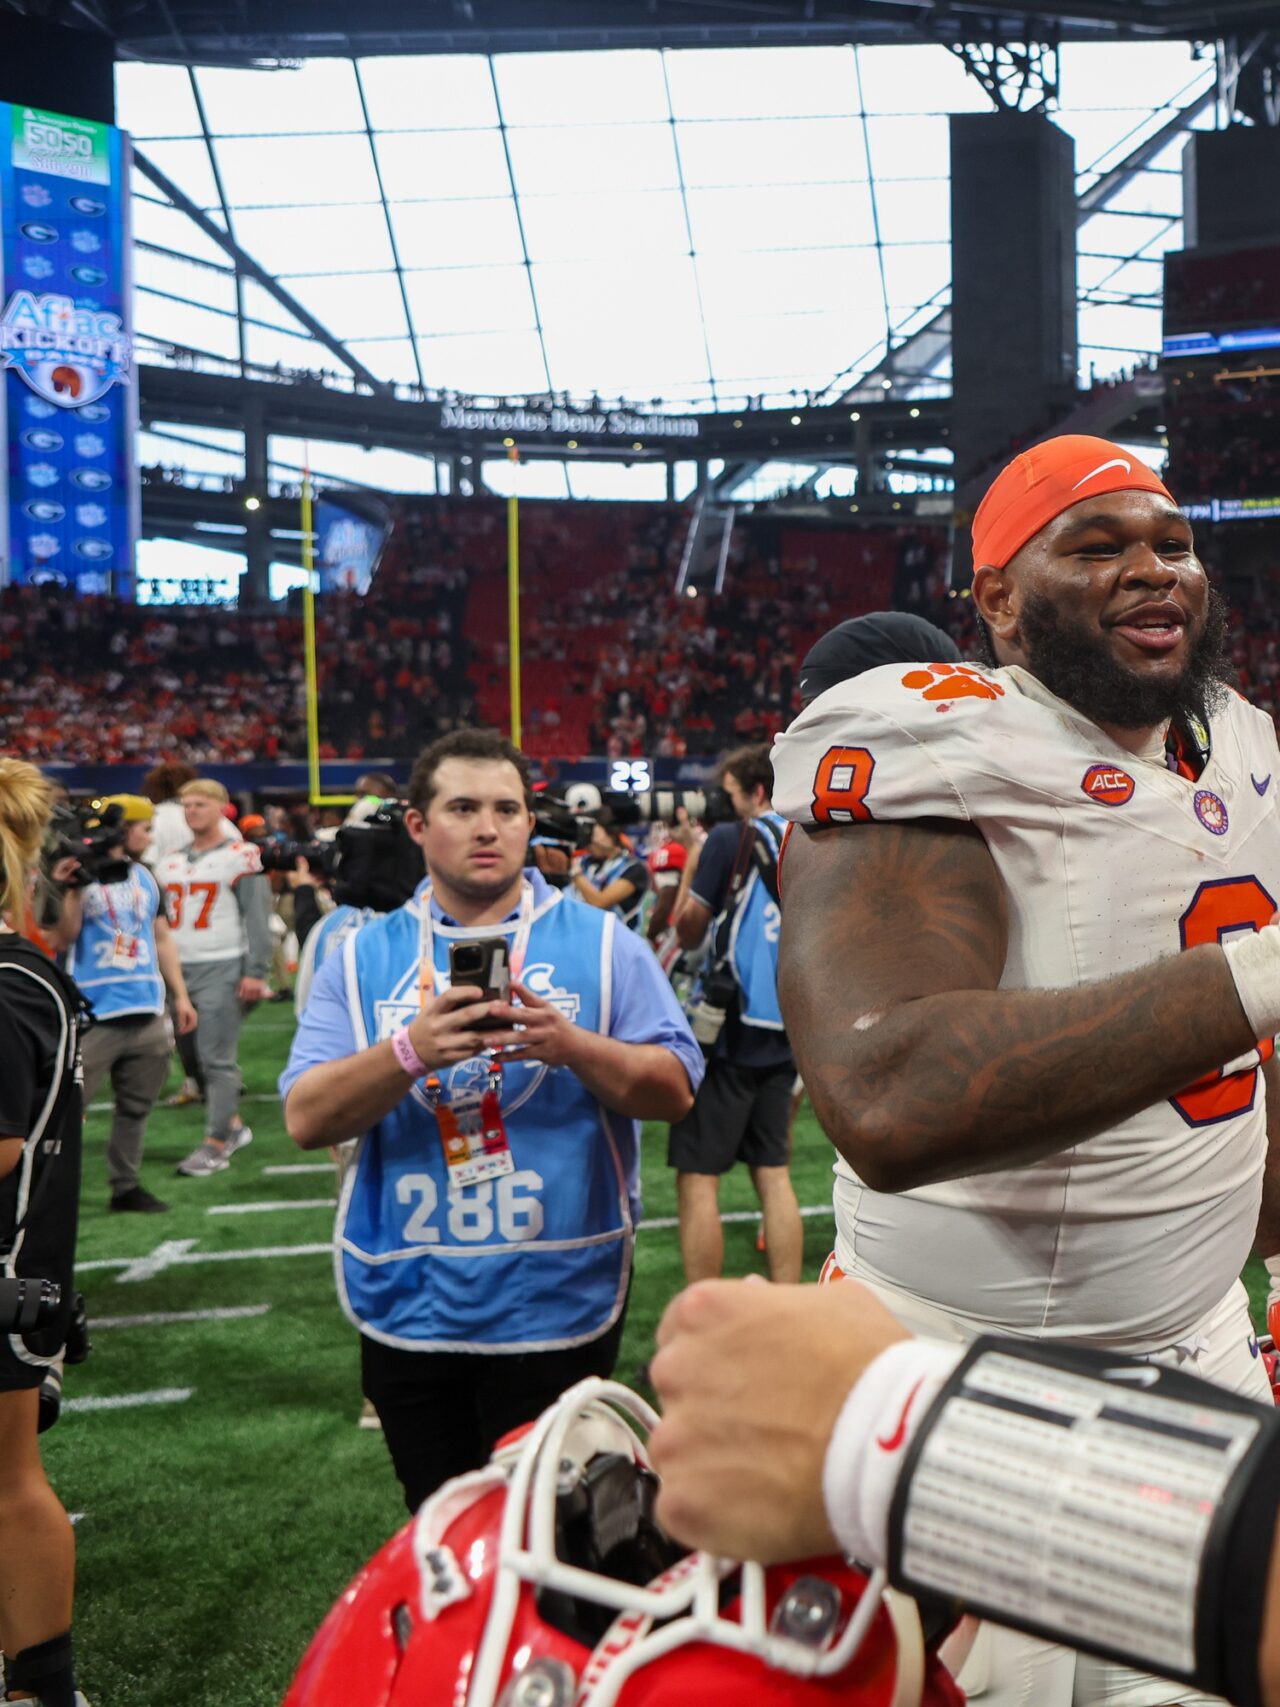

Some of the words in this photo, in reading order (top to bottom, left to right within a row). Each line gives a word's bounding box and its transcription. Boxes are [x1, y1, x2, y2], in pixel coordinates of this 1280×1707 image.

[441, 405, 606, 434] Mercedes-Benz
[608, 411, 699, 437] Stadium
[611, 761, 650, 791] 25
[812, 745, 876, 822] 8
[1091, 773, 1128, 790] ACC
[396, 1170, 544, 1243] 286
